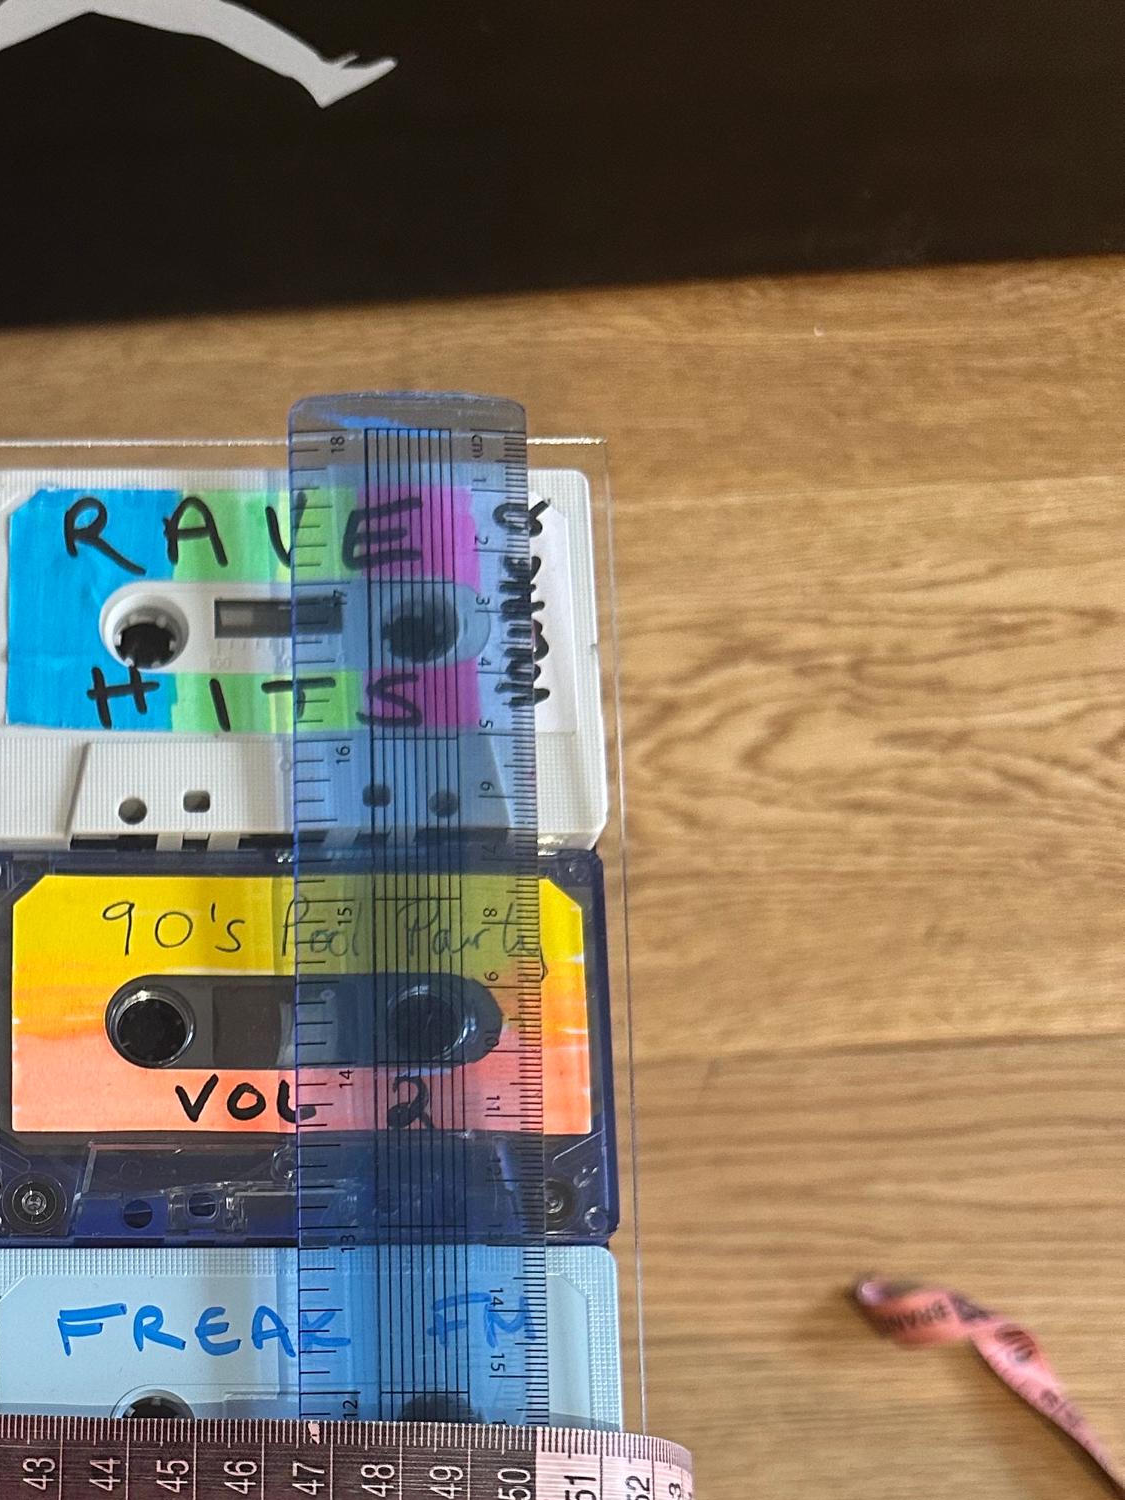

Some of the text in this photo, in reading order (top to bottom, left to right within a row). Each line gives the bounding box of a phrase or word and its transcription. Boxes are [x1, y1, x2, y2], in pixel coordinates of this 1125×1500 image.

[330, 435, 345, 454] 18
[64, 491, 422, 575] RAVE
[475, 535, 488, 546] 2
[476, 596, 490, 607] 3
[479, 656, 491, 668] 4
[87, 665, 422, 732] HITS
[479, 718, 493, 729] 5
[336, 745, 350, 765] 16
[480, 780, 494, 791] 6
[337, 906, 352, 926] 15
[484, 907, 497, 917] 8
[101, 895, 549, 982] 90's Pool Party
[339, 1069, 353, 1089] 14
[174, 1074, 434, 1129] VOL 2
[486, 1095, 501, 1112] 11
[340, 1234, 355, 1253] 13
[490, 1286, 504, 1307] 14
[57, 1292, 537, 1359] FREAK FM
[490, 1353, 505, 1372] 15
[22, 1456, 56, 1491] 43
[89, 1457, 122, 1492] 44
[156, 1459, 190, 1493] 45
[223, 1460, 258, 1494] 46
[292, 1461, 325, 1496] 47
[361, 1464, 395, 1498] 48
[429, 1465, 463, 1500] 49
